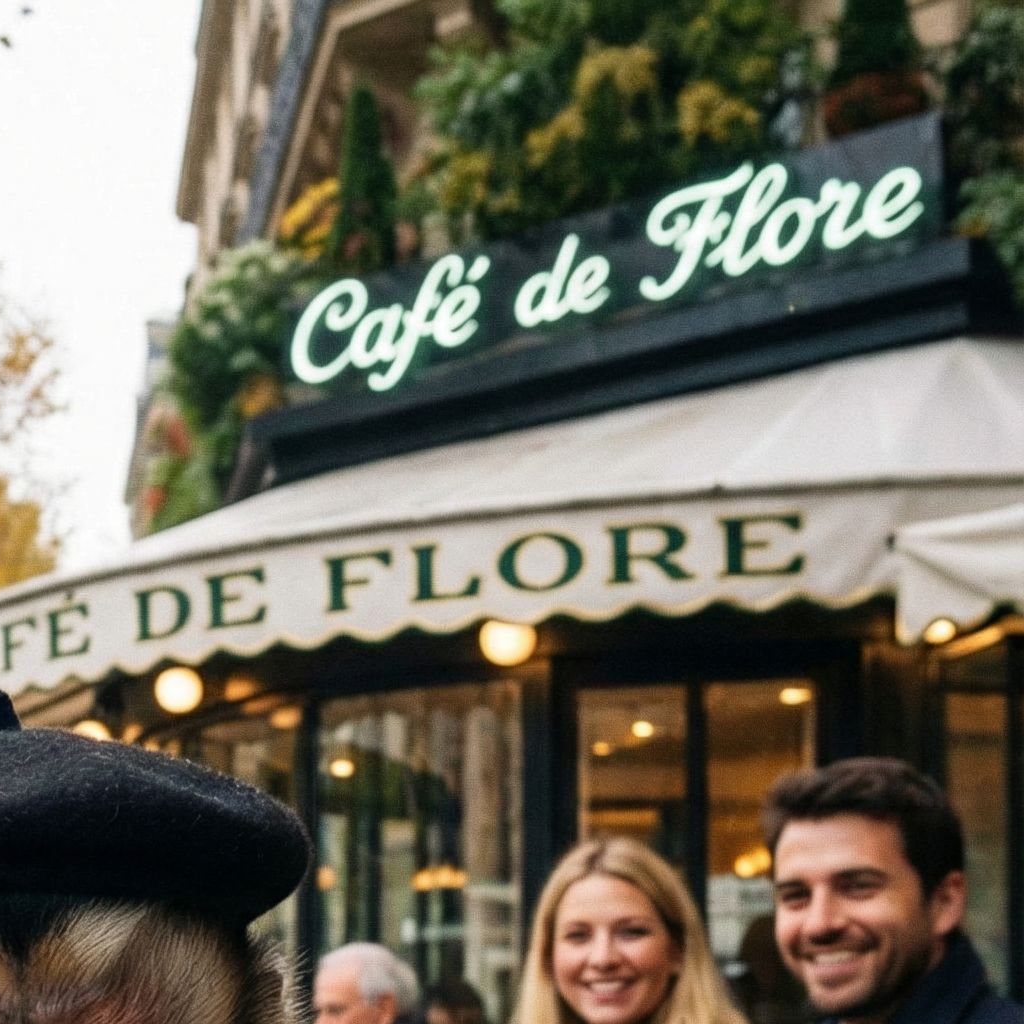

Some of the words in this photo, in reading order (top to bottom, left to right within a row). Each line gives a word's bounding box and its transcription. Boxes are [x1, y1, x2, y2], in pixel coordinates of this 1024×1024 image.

[290, 253, 491, 391] Café
[514, 233, 611, 327] de
[638, 161, 924, 301] Flore
[135, 565, 267, 641] DE
[325, 511, 809, 614] FLORE
